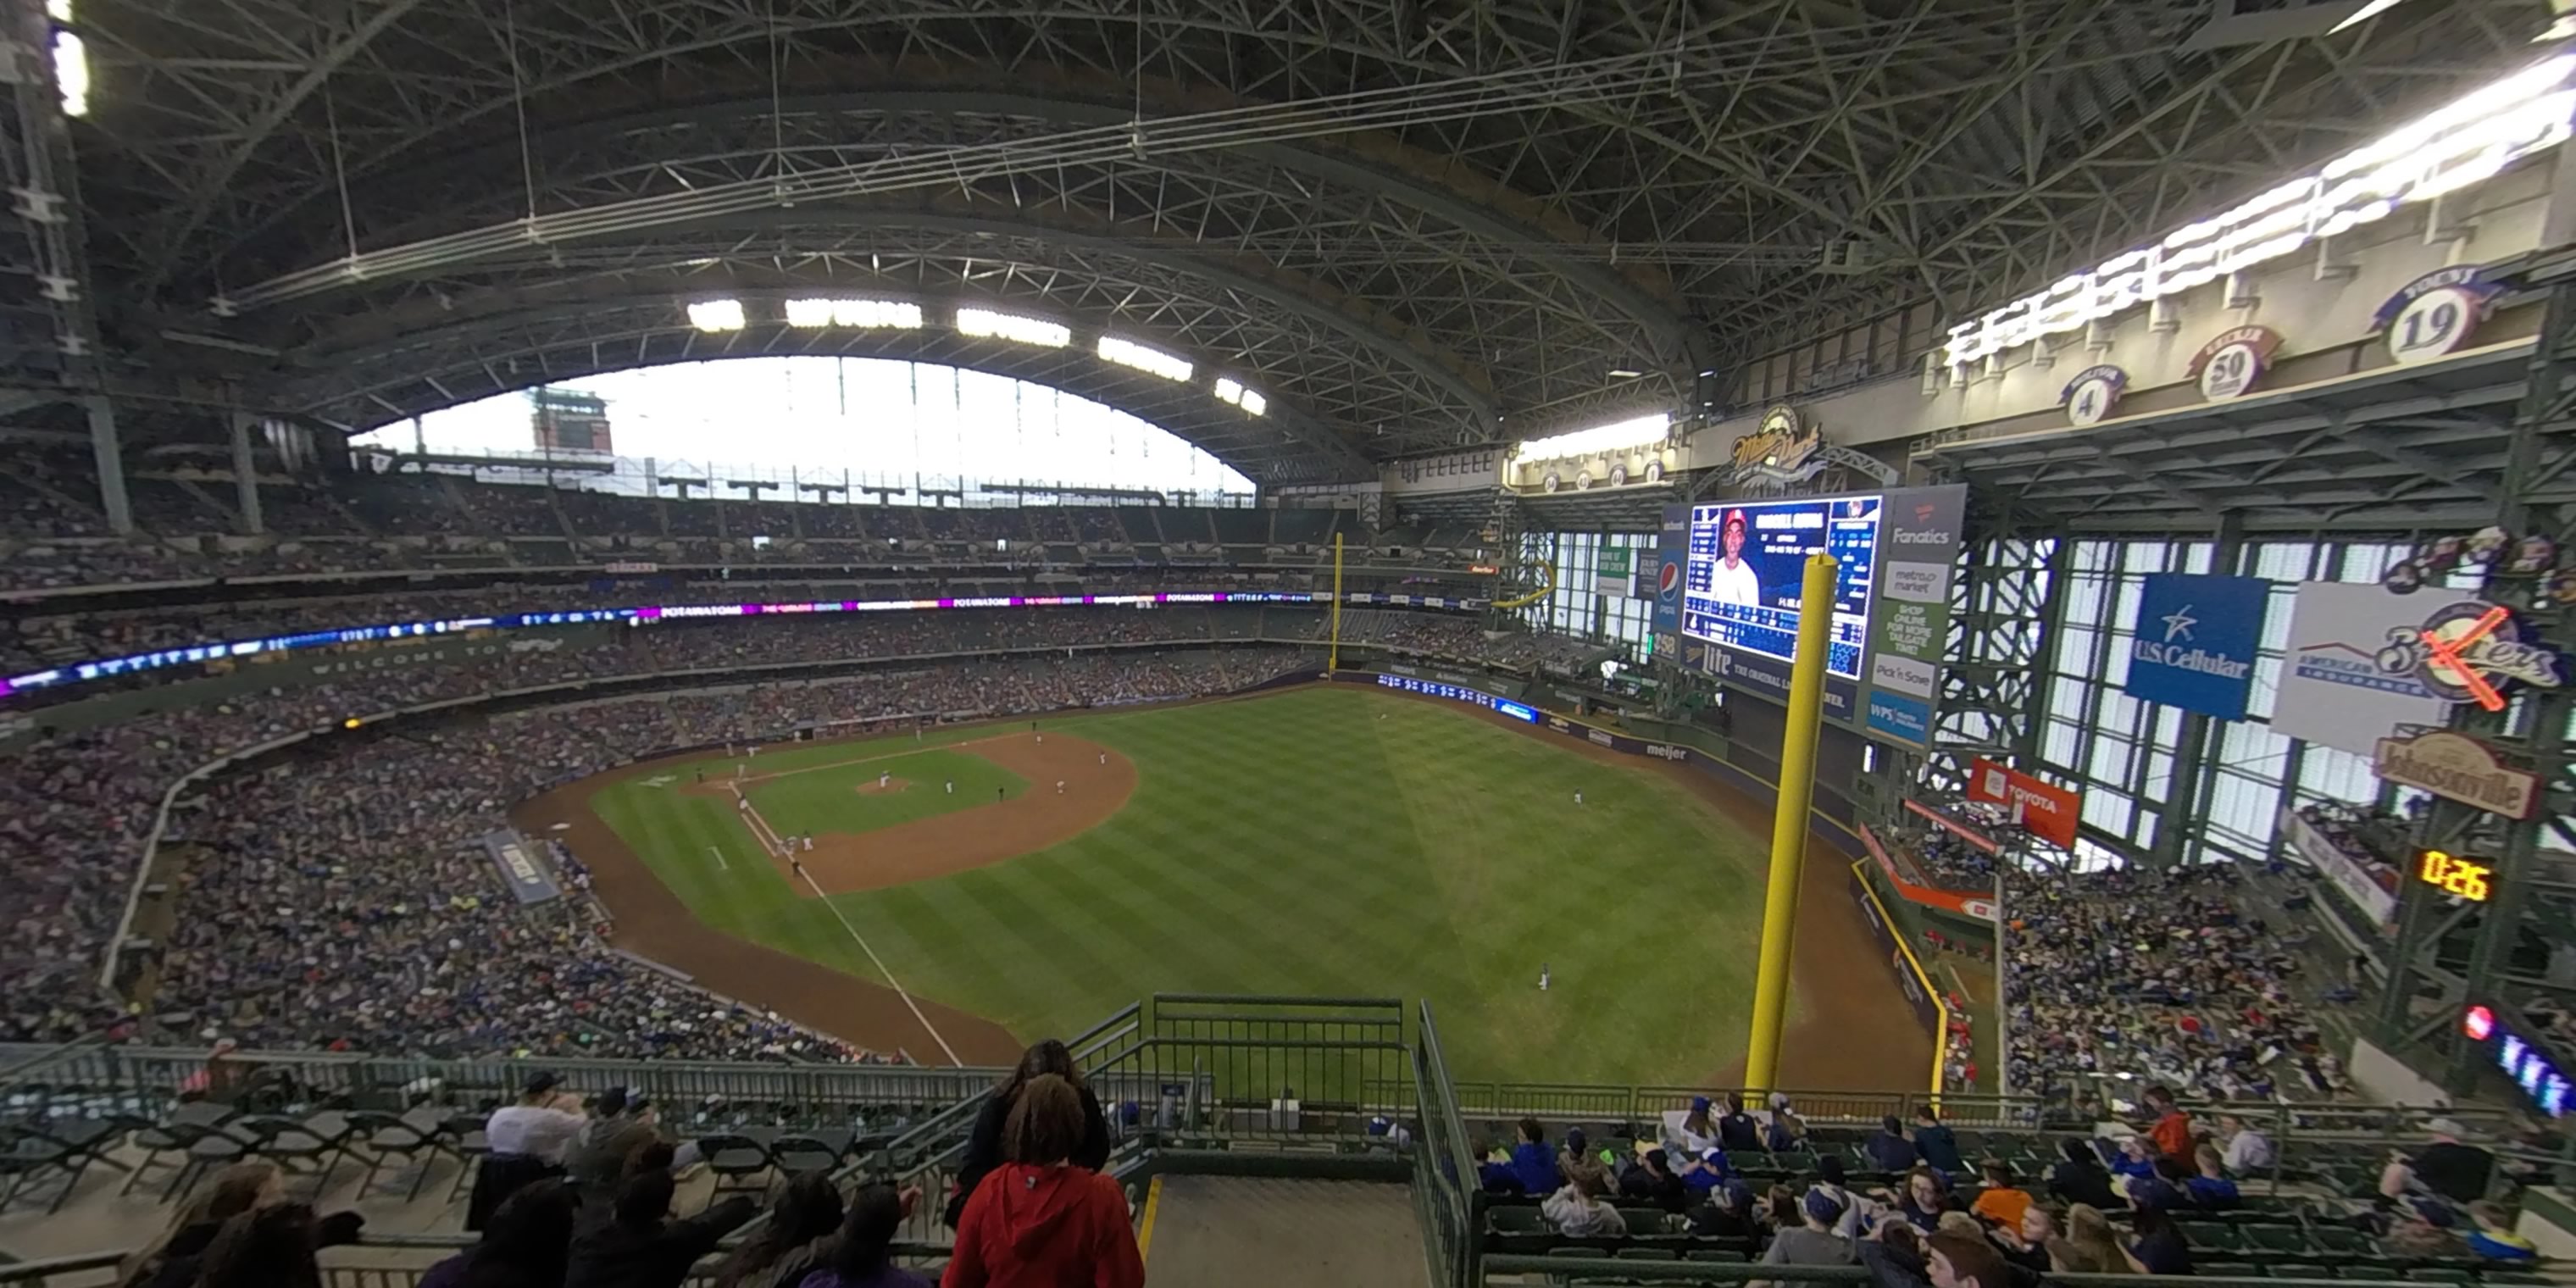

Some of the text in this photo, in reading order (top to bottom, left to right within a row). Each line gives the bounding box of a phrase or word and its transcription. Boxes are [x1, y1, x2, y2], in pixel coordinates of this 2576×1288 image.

[2398, 303, 2457, 353] 19
[2210, 351, 2246, 382] 50
[2078, 388, 2096, 417] 4
[1892, 527, 1950, 544] Fanatics
[1894, 581, 1929, 593] market
[1905, 625, 1932, 637] MORE
[312, 650, 444, 675] WELCOME
[466, 645, 496, 656] TO
[1702, 644, 1731, 676] Lite
[2165, 645, 2251, 680] Cellular
[1870, 703, 1893, 721] WPS
[1646, 745, 1686, 760] meijer
[2379, 744, 2522, 810] Johnsonville
[2008, 784, 2057, 814] TOYOTA
[2421, 850, 2490, 901] 0:26
